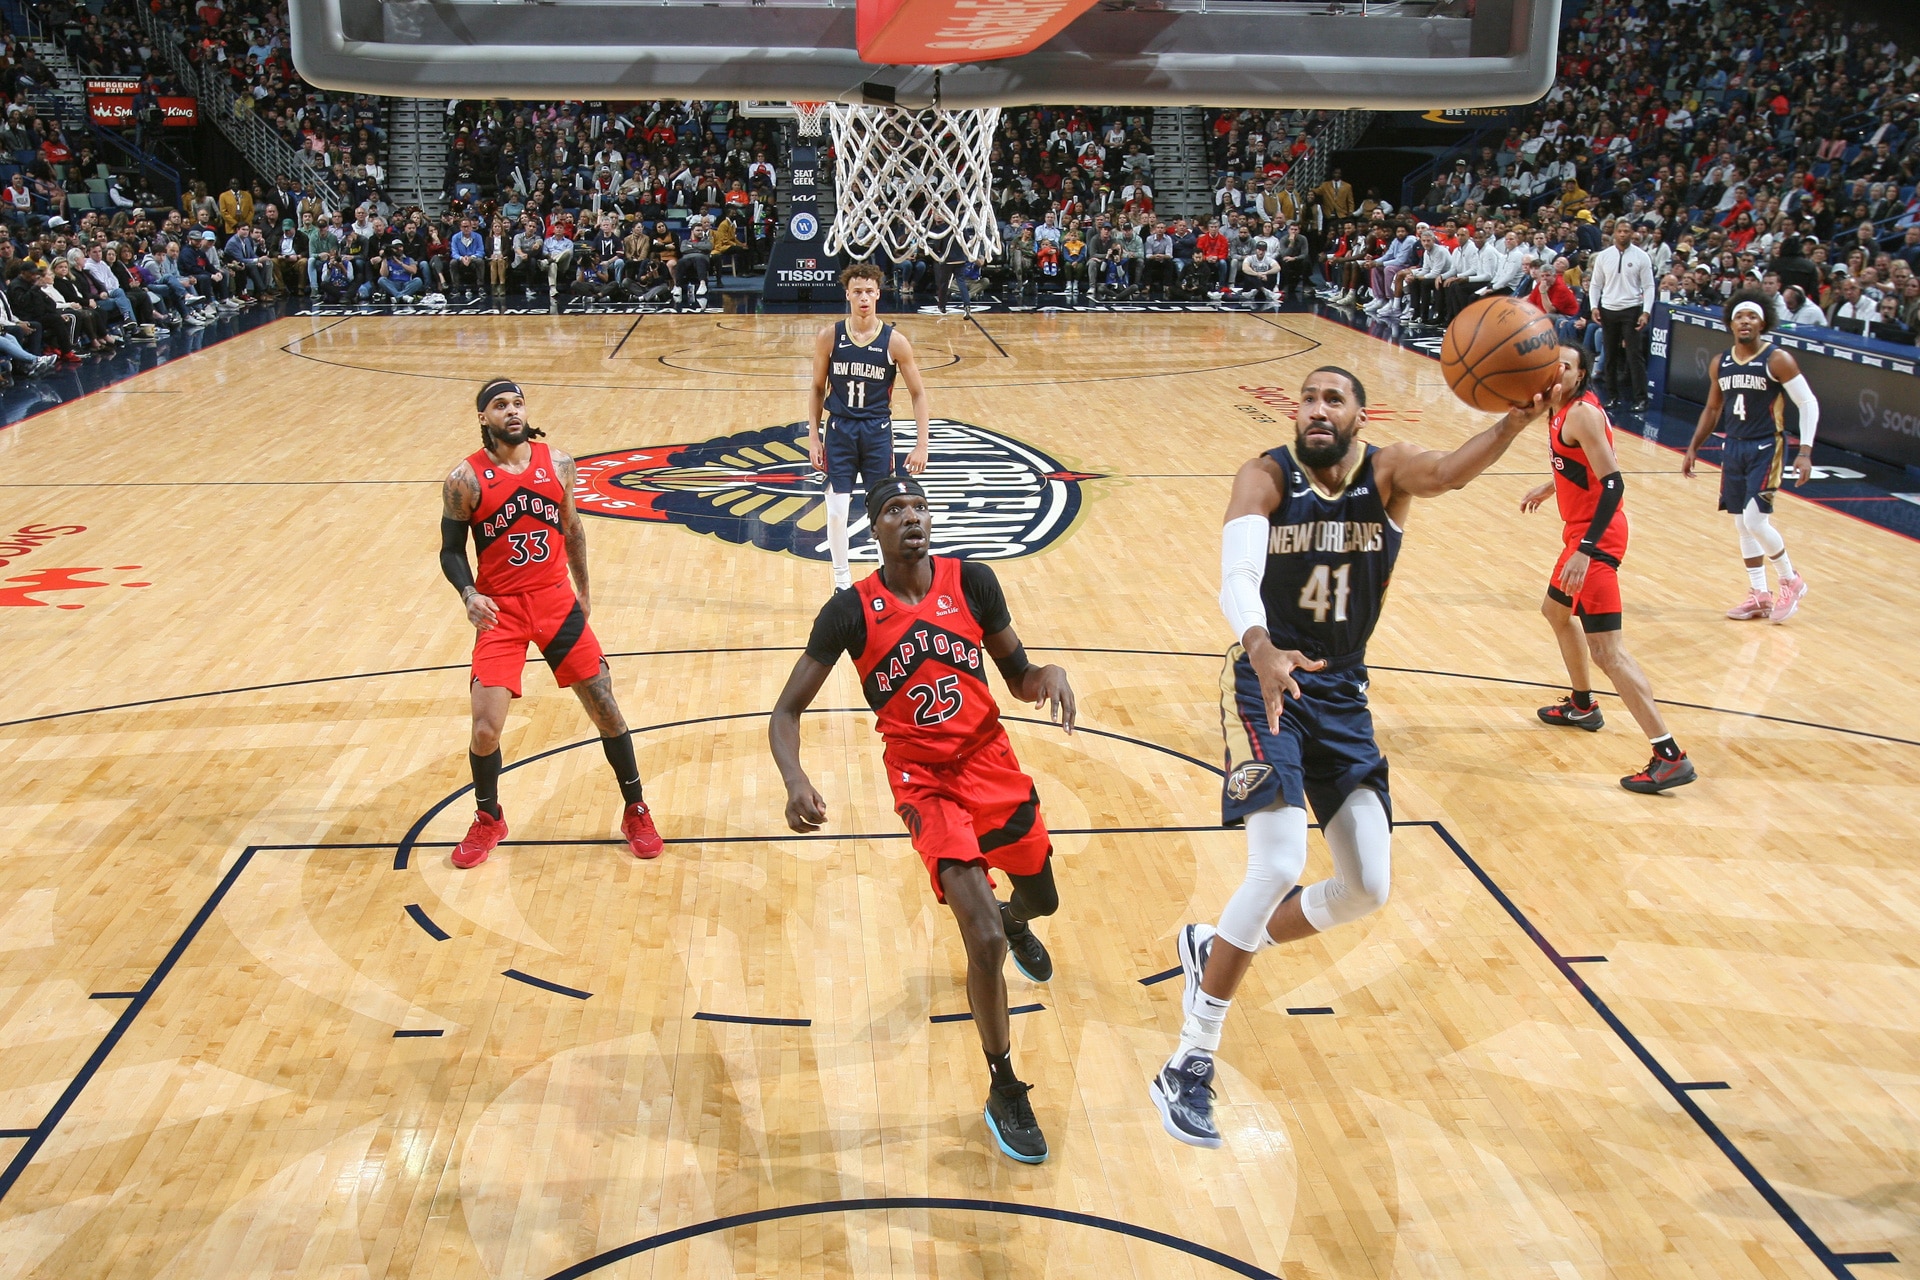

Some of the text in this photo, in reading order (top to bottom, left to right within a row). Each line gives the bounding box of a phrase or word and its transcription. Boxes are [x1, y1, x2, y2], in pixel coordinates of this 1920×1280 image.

[88, 81, 140, 89] EMERGENCY
[792, 177, 815, 186] GEEK
[793, 169, 814, 178] SEAT
[776, 270, 836, 281] TISSOT
[392, 308, 550, 316] ORLEANS
[1652, 327, 1668, 343] SEAT
[1650, 342, 1668, 359] GEEK
[832, 361, 886, 380] NEW ORLEANS
[1731, 374, 1767, 391] ORLEANS
[846, 380, 866, 408] 11
[1733, 393, 1746, 421] 4
[484, 469, 494, 479] 6
[1269, 520, 1384, 554] NEW ORLEANS
[507, 529, 551, 567] 33
[1297, 563, 1352, 623] 41
[873, 598, 884, 611] 6
[935, 606, 959, 617] Sun Life
[875, 629, 980, 691] RAPTORS
[906, 674, 963, 727] 25
